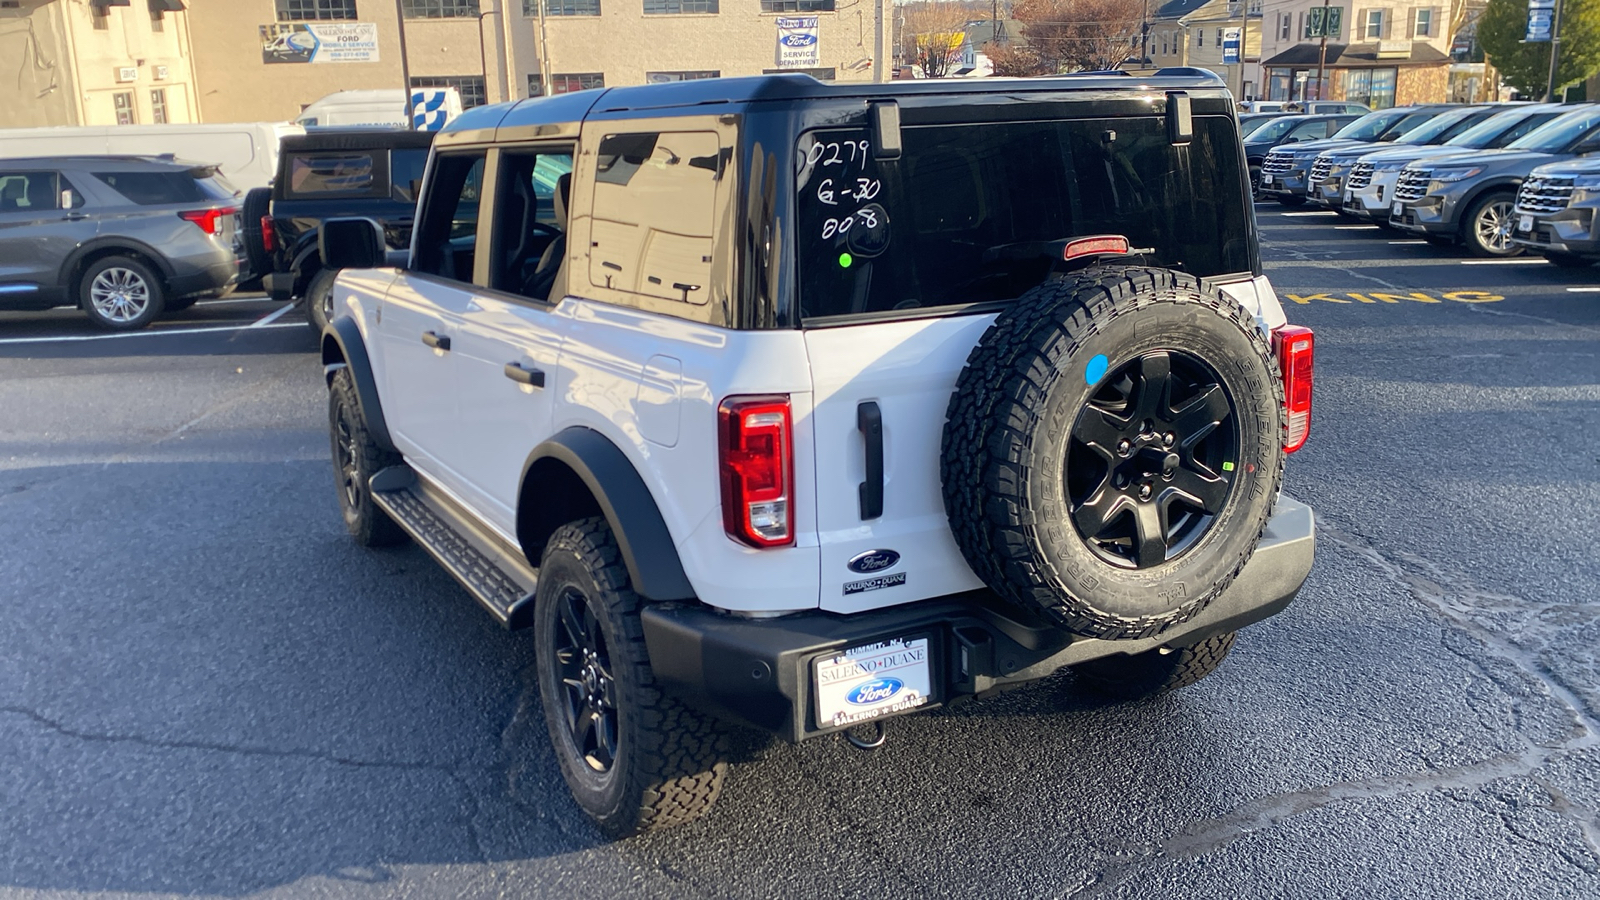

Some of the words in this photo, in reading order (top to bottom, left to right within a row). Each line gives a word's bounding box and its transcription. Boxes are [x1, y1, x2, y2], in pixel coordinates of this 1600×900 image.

[337, 35, 359, 43] FORD
[787, 34, 811, 46] Ford
[807, 140, 870, 170] 0279
[1280, 290, 1505, 304] KING
[1236, 356, 1272, 501] GENERAL
[1041, 456, 1099, 593] GRABBER
[861, 554, 889, 570] Ford
[821, 660, 877, 683] SALERNO
[883, 648, 924, 668] DUANE
[856, 682, 893, 703] Ford
[833, 708, 879, 727] SALERNO
[892, 697, 924, 712] DUANE
